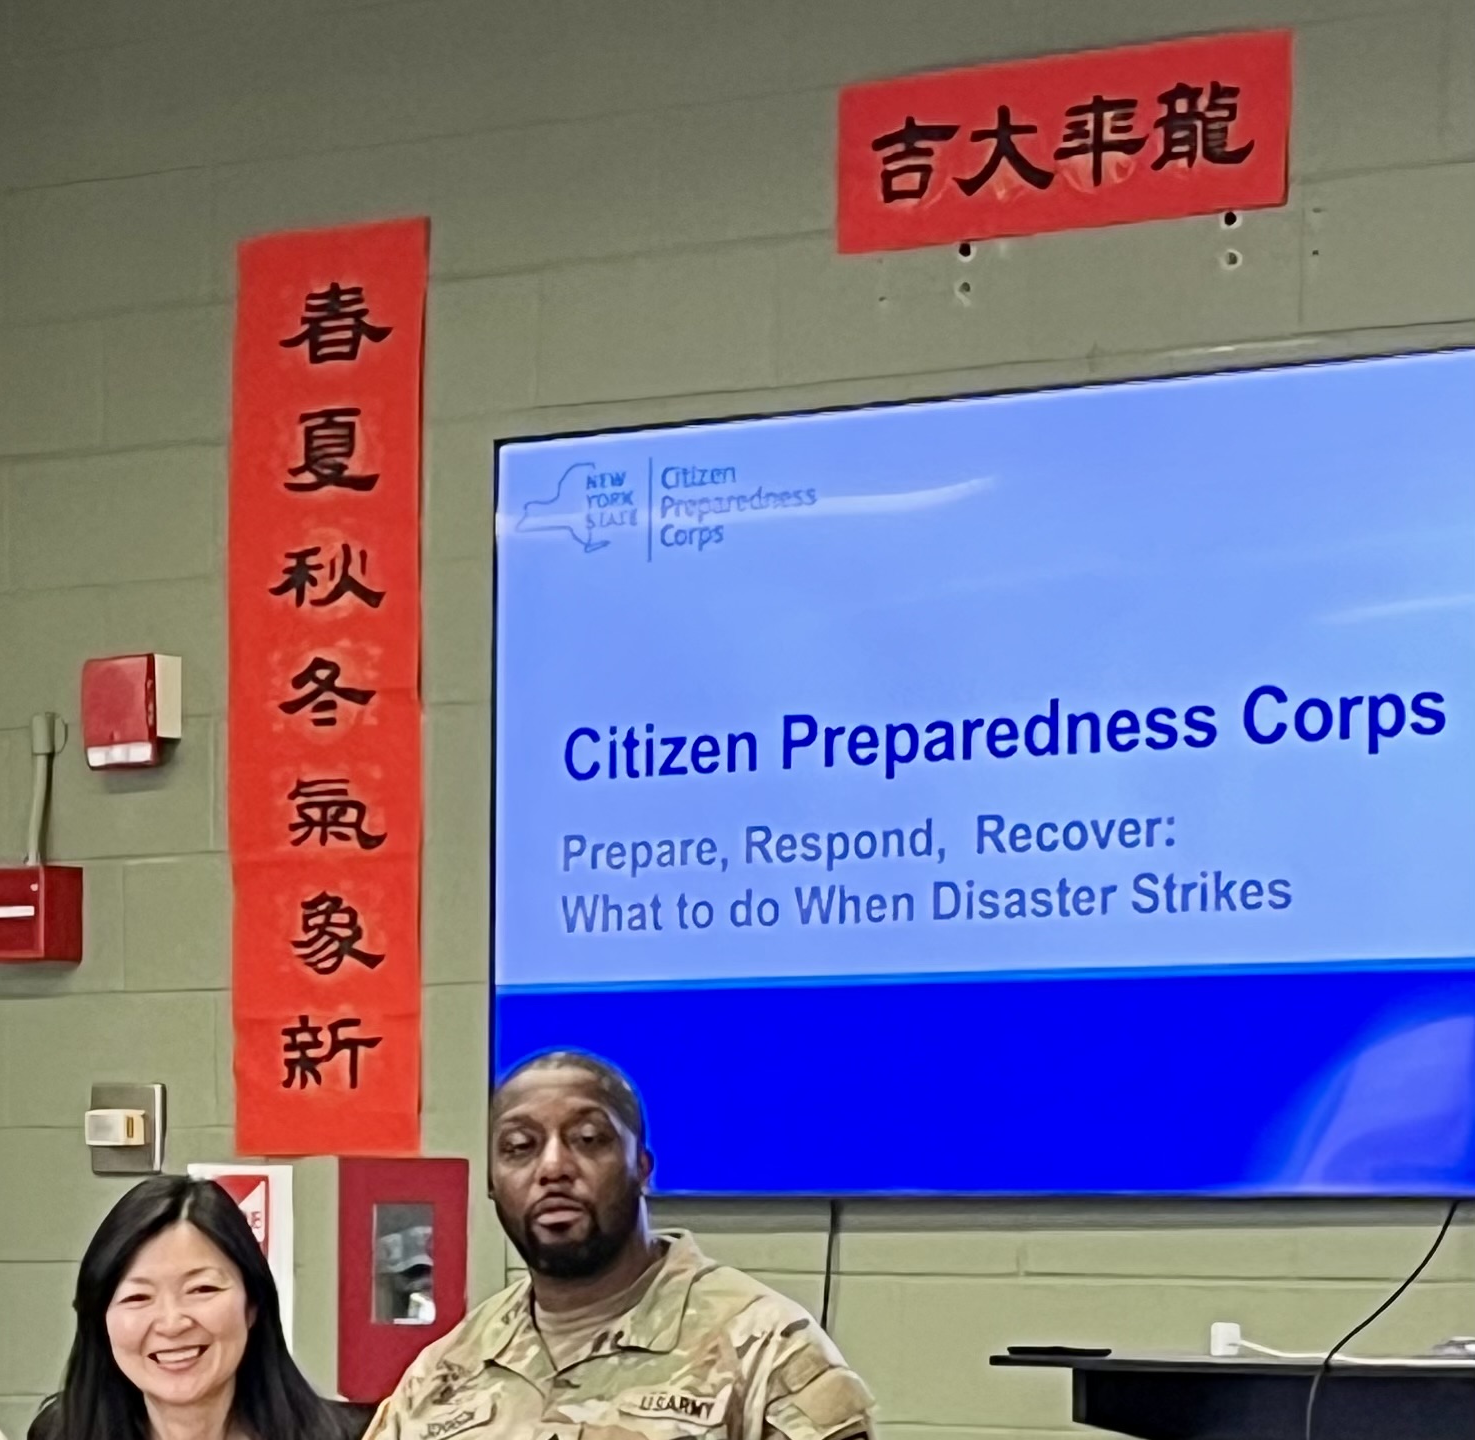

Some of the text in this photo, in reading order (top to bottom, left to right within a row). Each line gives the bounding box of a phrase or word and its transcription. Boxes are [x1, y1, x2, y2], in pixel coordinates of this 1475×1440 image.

[586, 471, 627, 491] NEW
[661, 465, 736, 490] Citizen
[586, 490, 634, 509] YORK
[661, 486, 817, 523] Preparedness
[661, 524, 724, 551] Corps
[564, 684, 1447, 781] Citizen Preparedness Corps
[562, 813, 1176, 878] Prepare, Respond, Recover:
[561, 870, 1293, 934] What to do When Disaster Strikes
